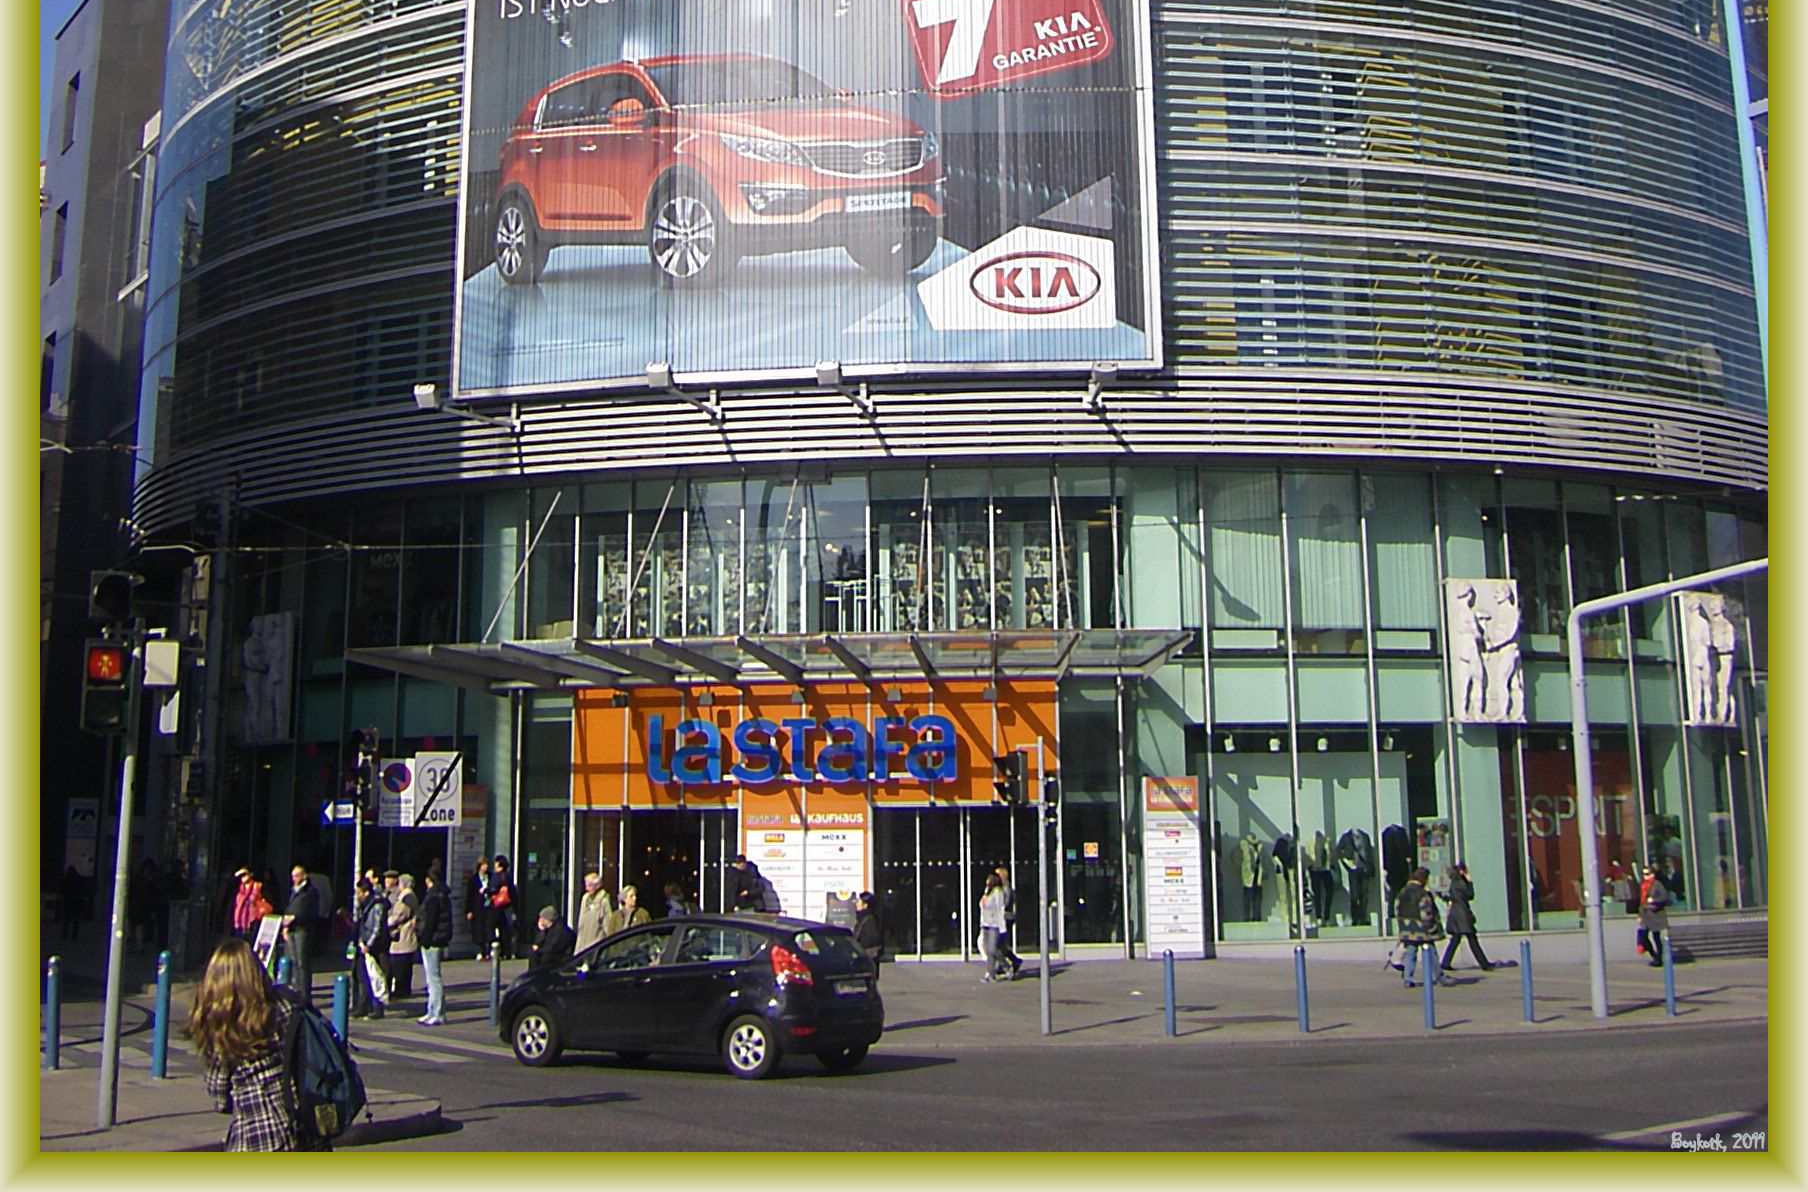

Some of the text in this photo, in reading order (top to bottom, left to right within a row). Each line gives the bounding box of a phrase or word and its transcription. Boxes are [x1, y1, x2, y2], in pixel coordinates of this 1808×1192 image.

[1033, 11, 1092, 40] KIA
[994, 266, 1079, 298] KIA
[1508, 795, 1627, 837] ESPIT
